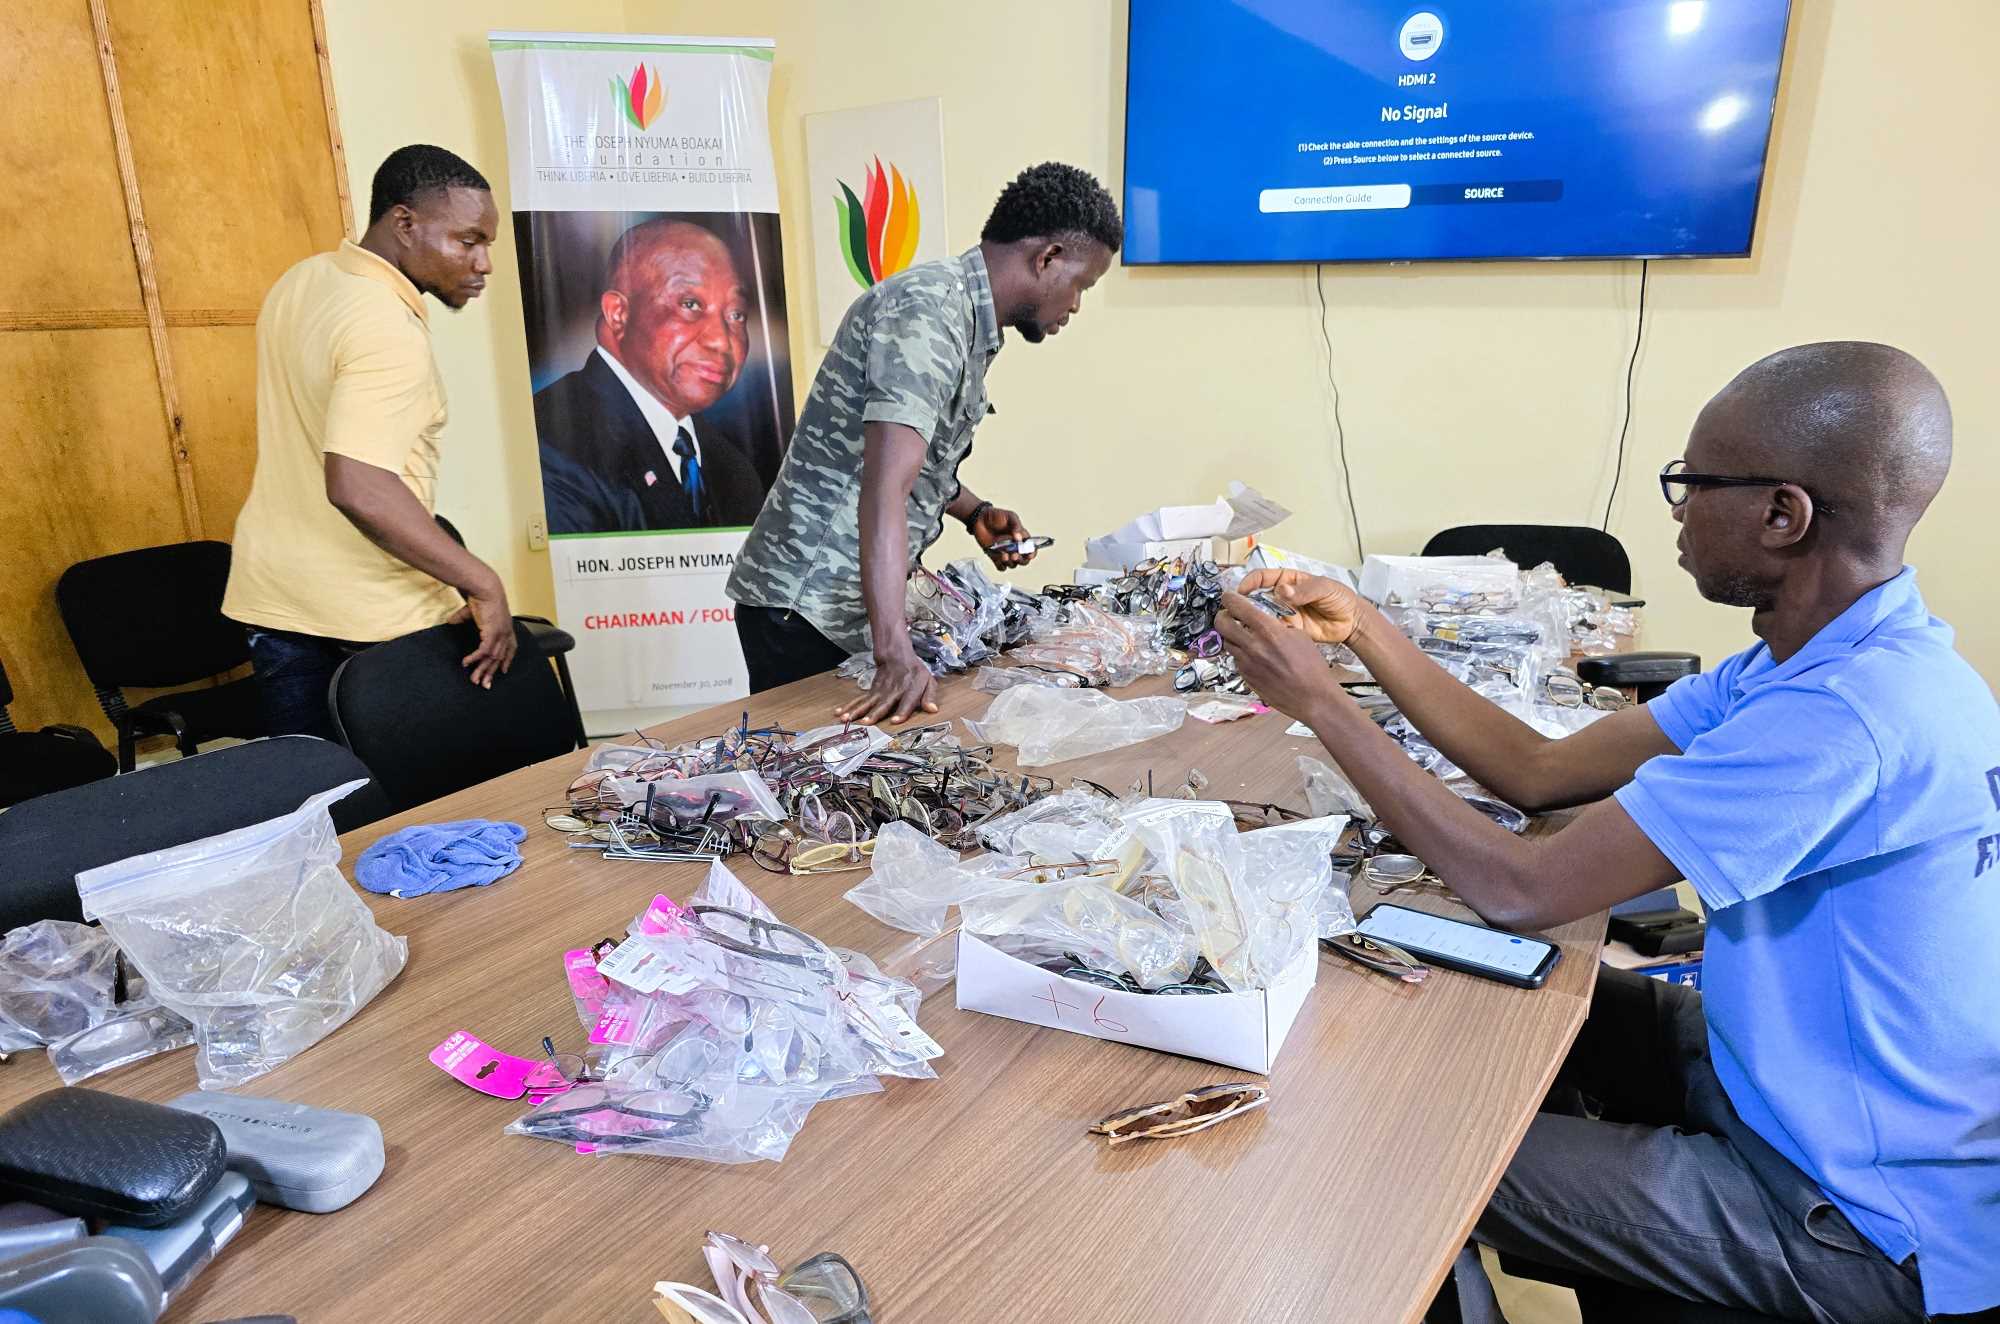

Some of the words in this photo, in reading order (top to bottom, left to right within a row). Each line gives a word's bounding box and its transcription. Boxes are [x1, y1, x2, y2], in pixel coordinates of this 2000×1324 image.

[1398, 74, 1427, 87] HDMI
[1429, 73, 1437, 84] 2
[1381, 107, 1401, 122] No
[1403, 102, 1448, 123] Signal
[588, 135, 632, 149] OSEPH
[635, 136, 678, 150] NYUMA
[681, 137, 722, 150] BOAKAI
[1298, 143, 1307, 152] (1)
[1308, 142, 1328, 151] Check
[1329, 141, 1341, 150] the
[1342, 140, 1360, 149] cable
[1361, 139, 1399, 148] connection
[1400, 138, 1414, 147] and
[1415, 136, 1428, 145] the
[1428, 135, 1458, 145] settings
[1459, 134, 1467, 143] of
[1468, 133, 1481, 142] the
[1482, 132, 1507, 141] source
[1508, 131, 1535, 140] device.
[1323, 156, 1333, 166] (2)
[1333, 156, 1352, 165] Press
[1352, 155, 1377, 164] Source
[1377, 154, 1399, 162] below
[1400, 153, 1408, 161] to
[1409, 151, 1431, 161] select
[1437, 150, 1475, 159] connected
[1476, 149, 1503, 157] source.
[536, 170, 566, 182] THINK
[617, 171, 641, 183] LOVE
[643, 172, 679, 183] LIBERIA
[689, 172, 717, 183] BUILD
[719, 172, 753, 184] LIBERIA
[1294, 192, 1344, 205] Connection
[1345, 192, 1373, 204] Guide
[1464, 187, 1505, 199] SOURCE
[577, 559, 614, 574] HON.
[618, 556, 675, 572] JOSEPH
[679, 553, 735, 568] NYUMA
[584, 610, 684, 630] CHAIRMAN
[689, 609, 698, 623] /
[652, 680, 697, 691] November
[712, 677, 733, 687] 2018
